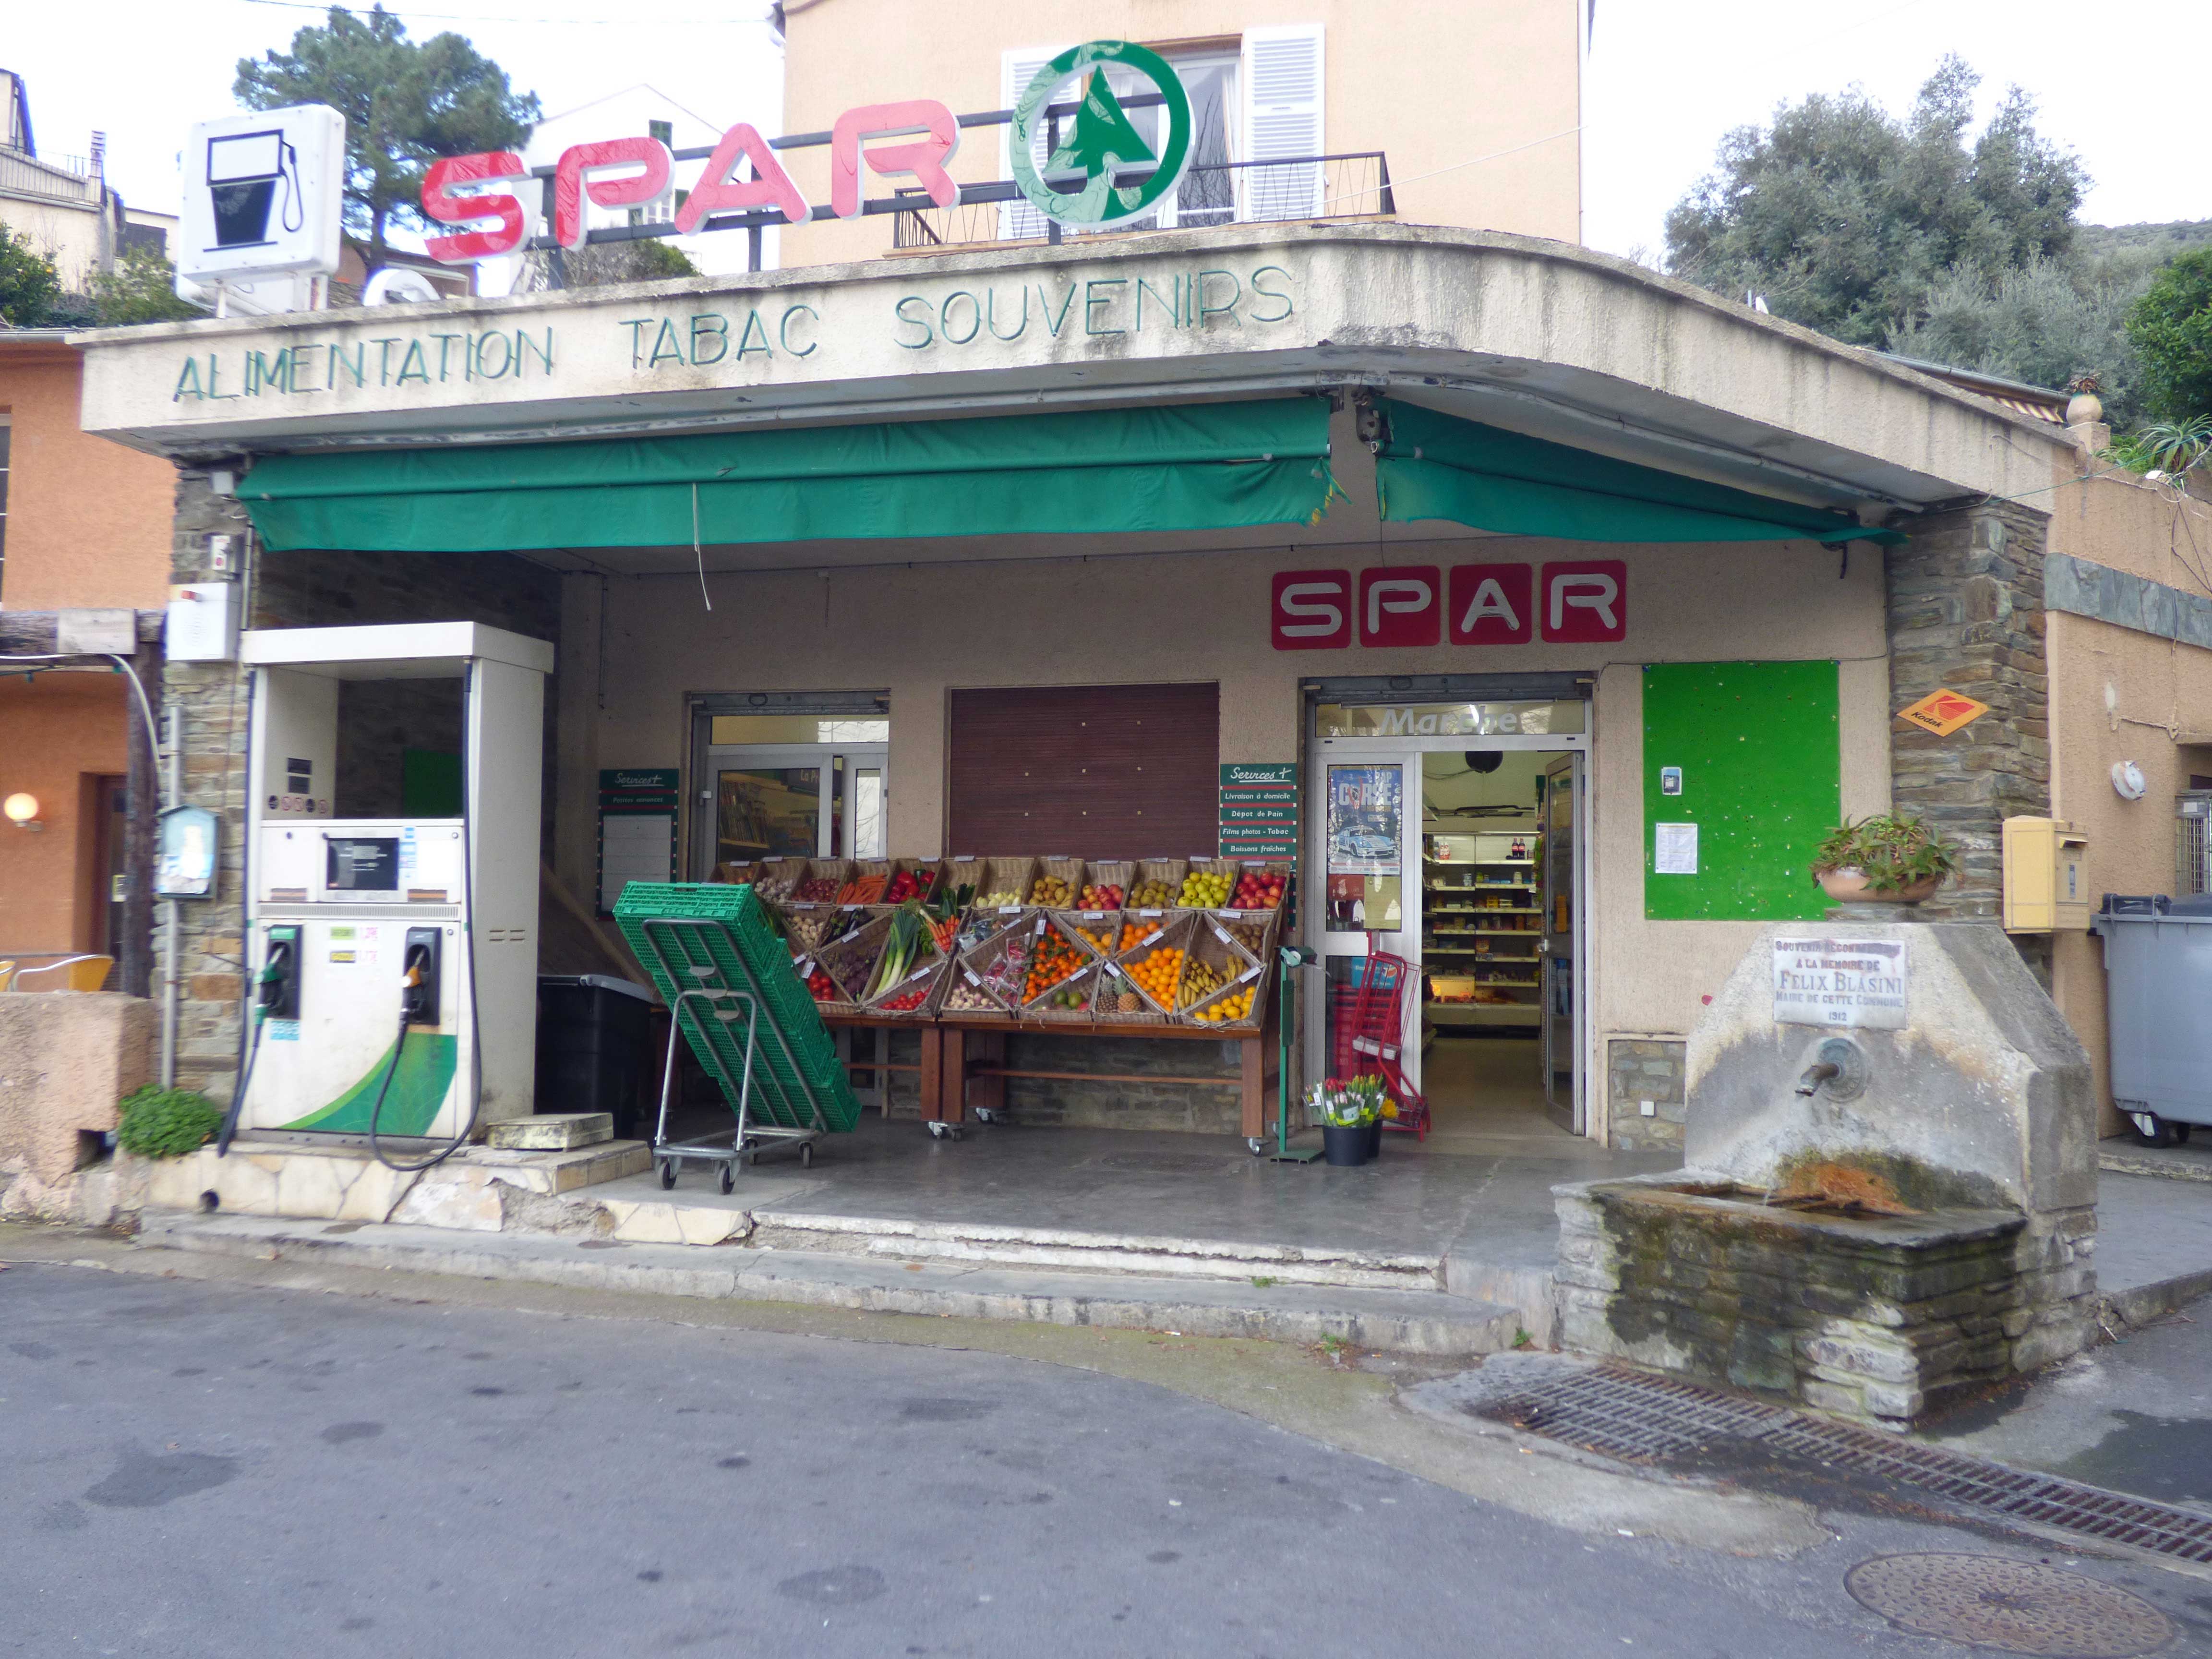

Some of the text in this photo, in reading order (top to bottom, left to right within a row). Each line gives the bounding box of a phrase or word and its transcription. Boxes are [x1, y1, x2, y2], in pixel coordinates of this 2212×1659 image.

[421, 98, 961, 265] SPAR
[173, 265, 1293, 403] ALIMENTATION TABAC SOUVENIRS
[1280, 573, 1618, 637] SPAR
[1379, 705, 1517, 735] Marché
[1911, 711, 1943, 728] Kodak
[1230, 767, 1275, 780] Services
[1805, 959, 1817, 969] LA
[1821, 960, 1863, 970] MEMOIRE
[1866, 961, 1880, 971] DE
[1779, 970, 1902, 994] FELIX BLASINI
[1776, 991, 1903, 1008] MAIRE DE CETTE COMMUNE
[1829, 1011, 1847, 1021] 1912
